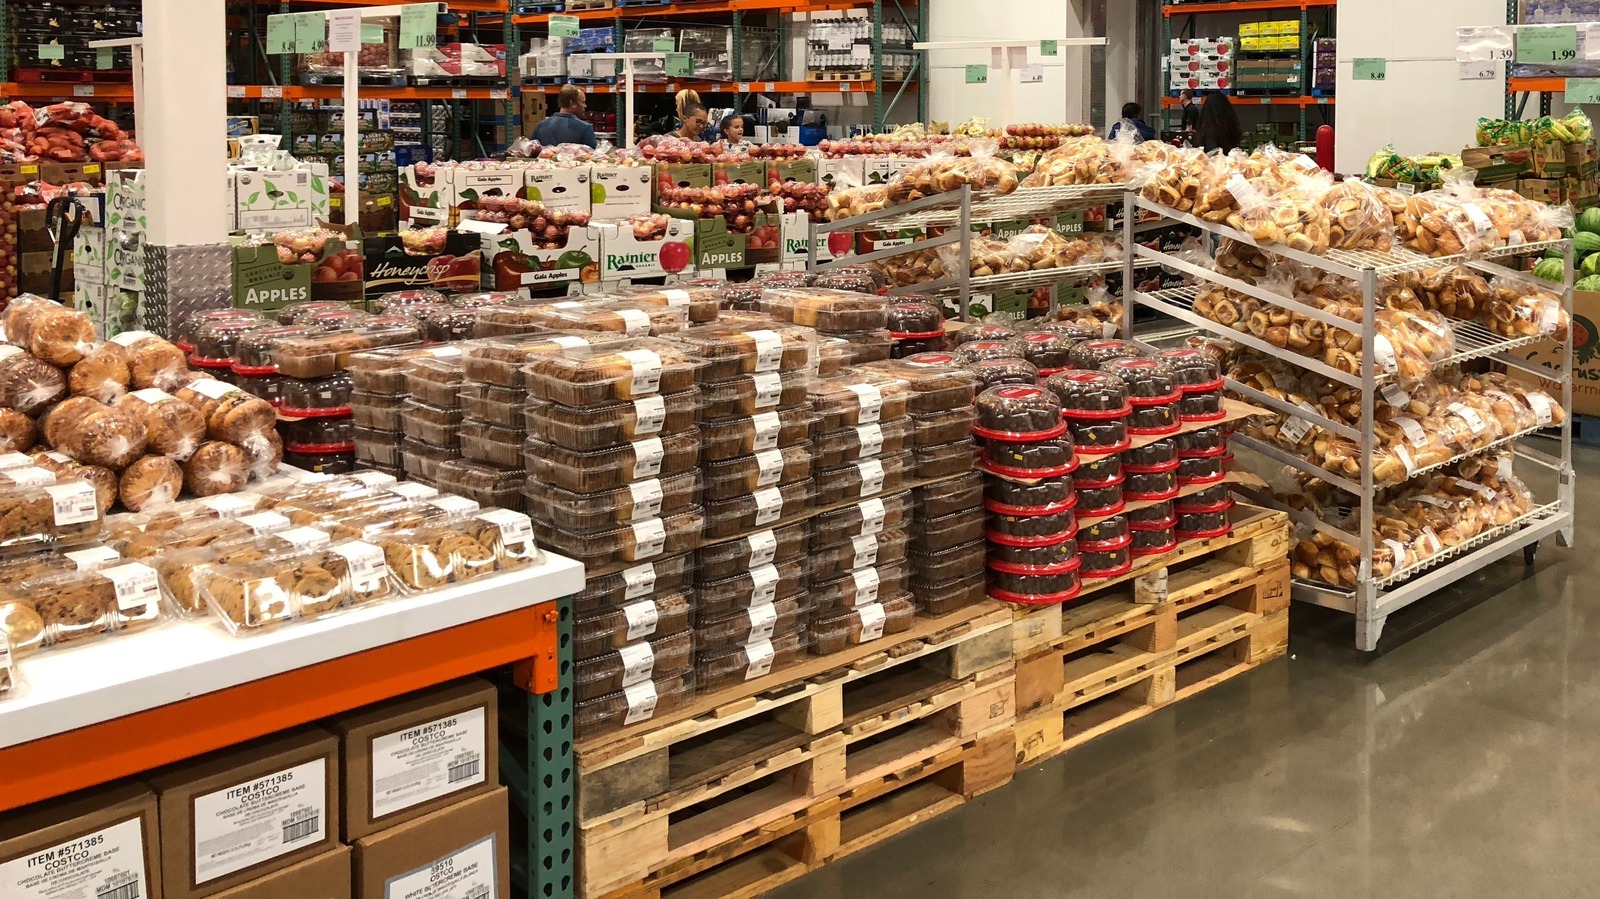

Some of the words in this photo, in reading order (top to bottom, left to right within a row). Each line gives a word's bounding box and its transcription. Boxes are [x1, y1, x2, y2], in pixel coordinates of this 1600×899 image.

[415, 34, 435, 47] 11.99
[1489, 49, 1512, 60] 1.39
[1551, 49, 1576, 61] 1.99
[1478, 70, 1495, 78] 6.79
[1588, 95, 1600, 103] 7.9
[997, 228, 1024, 239] APPLE
[1056, 223, 1082, 233] APPLES
[607, 252, 657, 270] Rainier
[701, 252, 743, 266] APPLES
[369, 261, 451, 285] Honeycrisp
[548, 271, 568, 279] Apples
[244, 286, 307, 305] APPLES
[400, 728, 421, 742] ITEM
[422, 718, 457, 735] #571385
[412, 730, 446, 746] COSTCO
[226, 785, 251, 800] ITEM
[253, 772, 293, 792] #571385
[240, 785, 280, 803] COSTCO
[27, 853, 55, 868] ITEM
[58, 834, 104, 858] #571385
[44, 849, 90, 871] COSTCO
